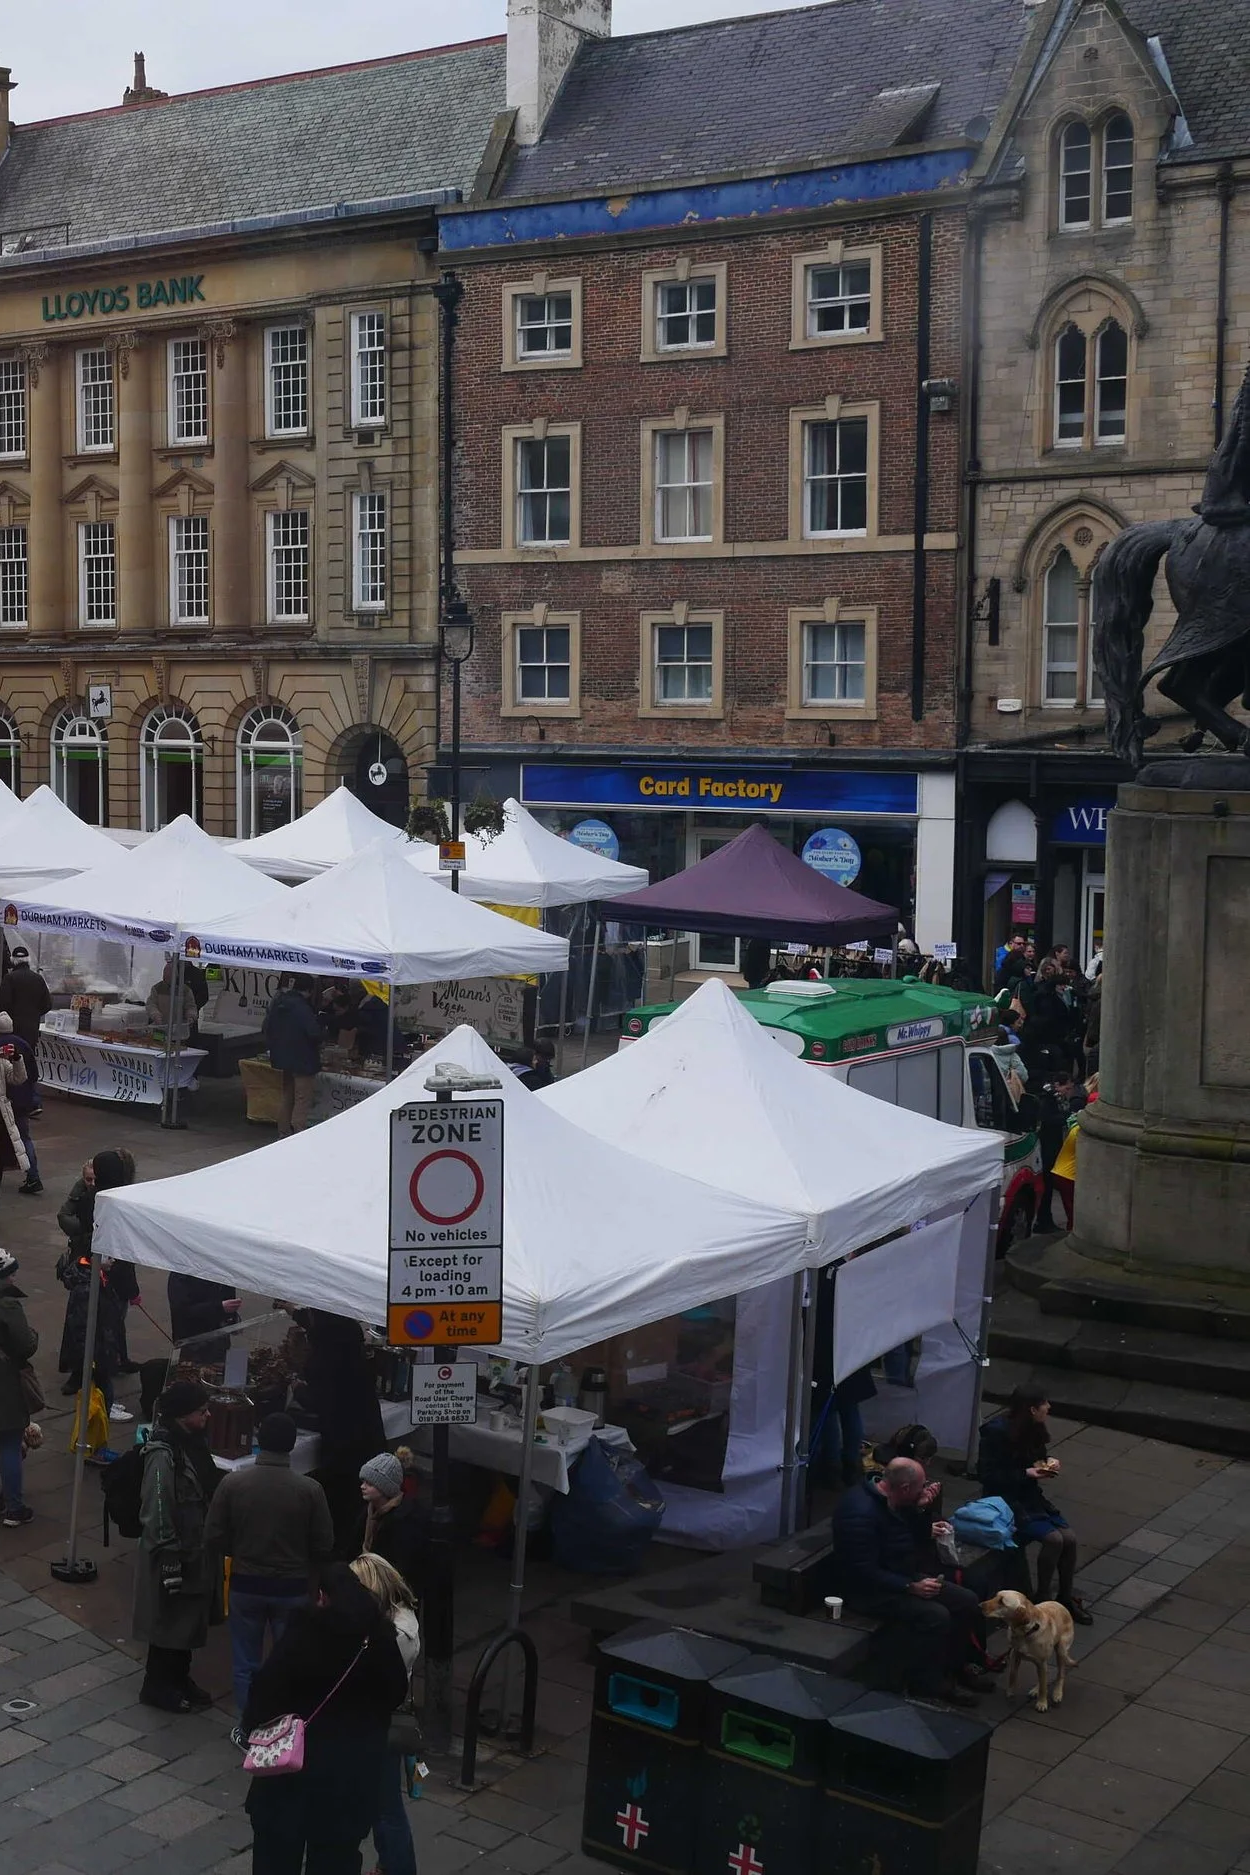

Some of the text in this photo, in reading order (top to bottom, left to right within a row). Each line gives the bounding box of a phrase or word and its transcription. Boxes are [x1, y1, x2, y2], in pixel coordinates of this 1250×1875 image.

[42, 274, 206, 321] LLOYDS BANK
[639, 775, 784, 803] Card Factory
[808, 854, 838, 863] Mother's
[21, 910, 107, 932] DURHAM MARKETS
[205, 942, 309, 964] DURHAM MARKETS
[223, 967, 281, 1000] KITC
[444, 980, 492, 1002] Mann's
[432, 991, 466, 1016] Vegan
[908, 1023, 932, 1040] Whippy
[100, 1050, 154, 1077] HANDMADE
[112, 1069, 148, 1094] SCOTCH
[398, 1106, 496, 1122] PEDESTRIAN
[411, 1123, 482, 1144] ZONE
[405, 1228, 487, 1242] No vehicles
[409, 1253, 483, 1269] Except for
[419, 1269, 471, 1282] loading
[402, 1285, 412, 1297] 4
[415, 1287, 436, 1299] pm
[449, 1284, 464, 1296] 10
[468, 1285, 488, 1295] am
[439, 1310, 486, 1323] At any
[446, 1324, 477, 1336] time
